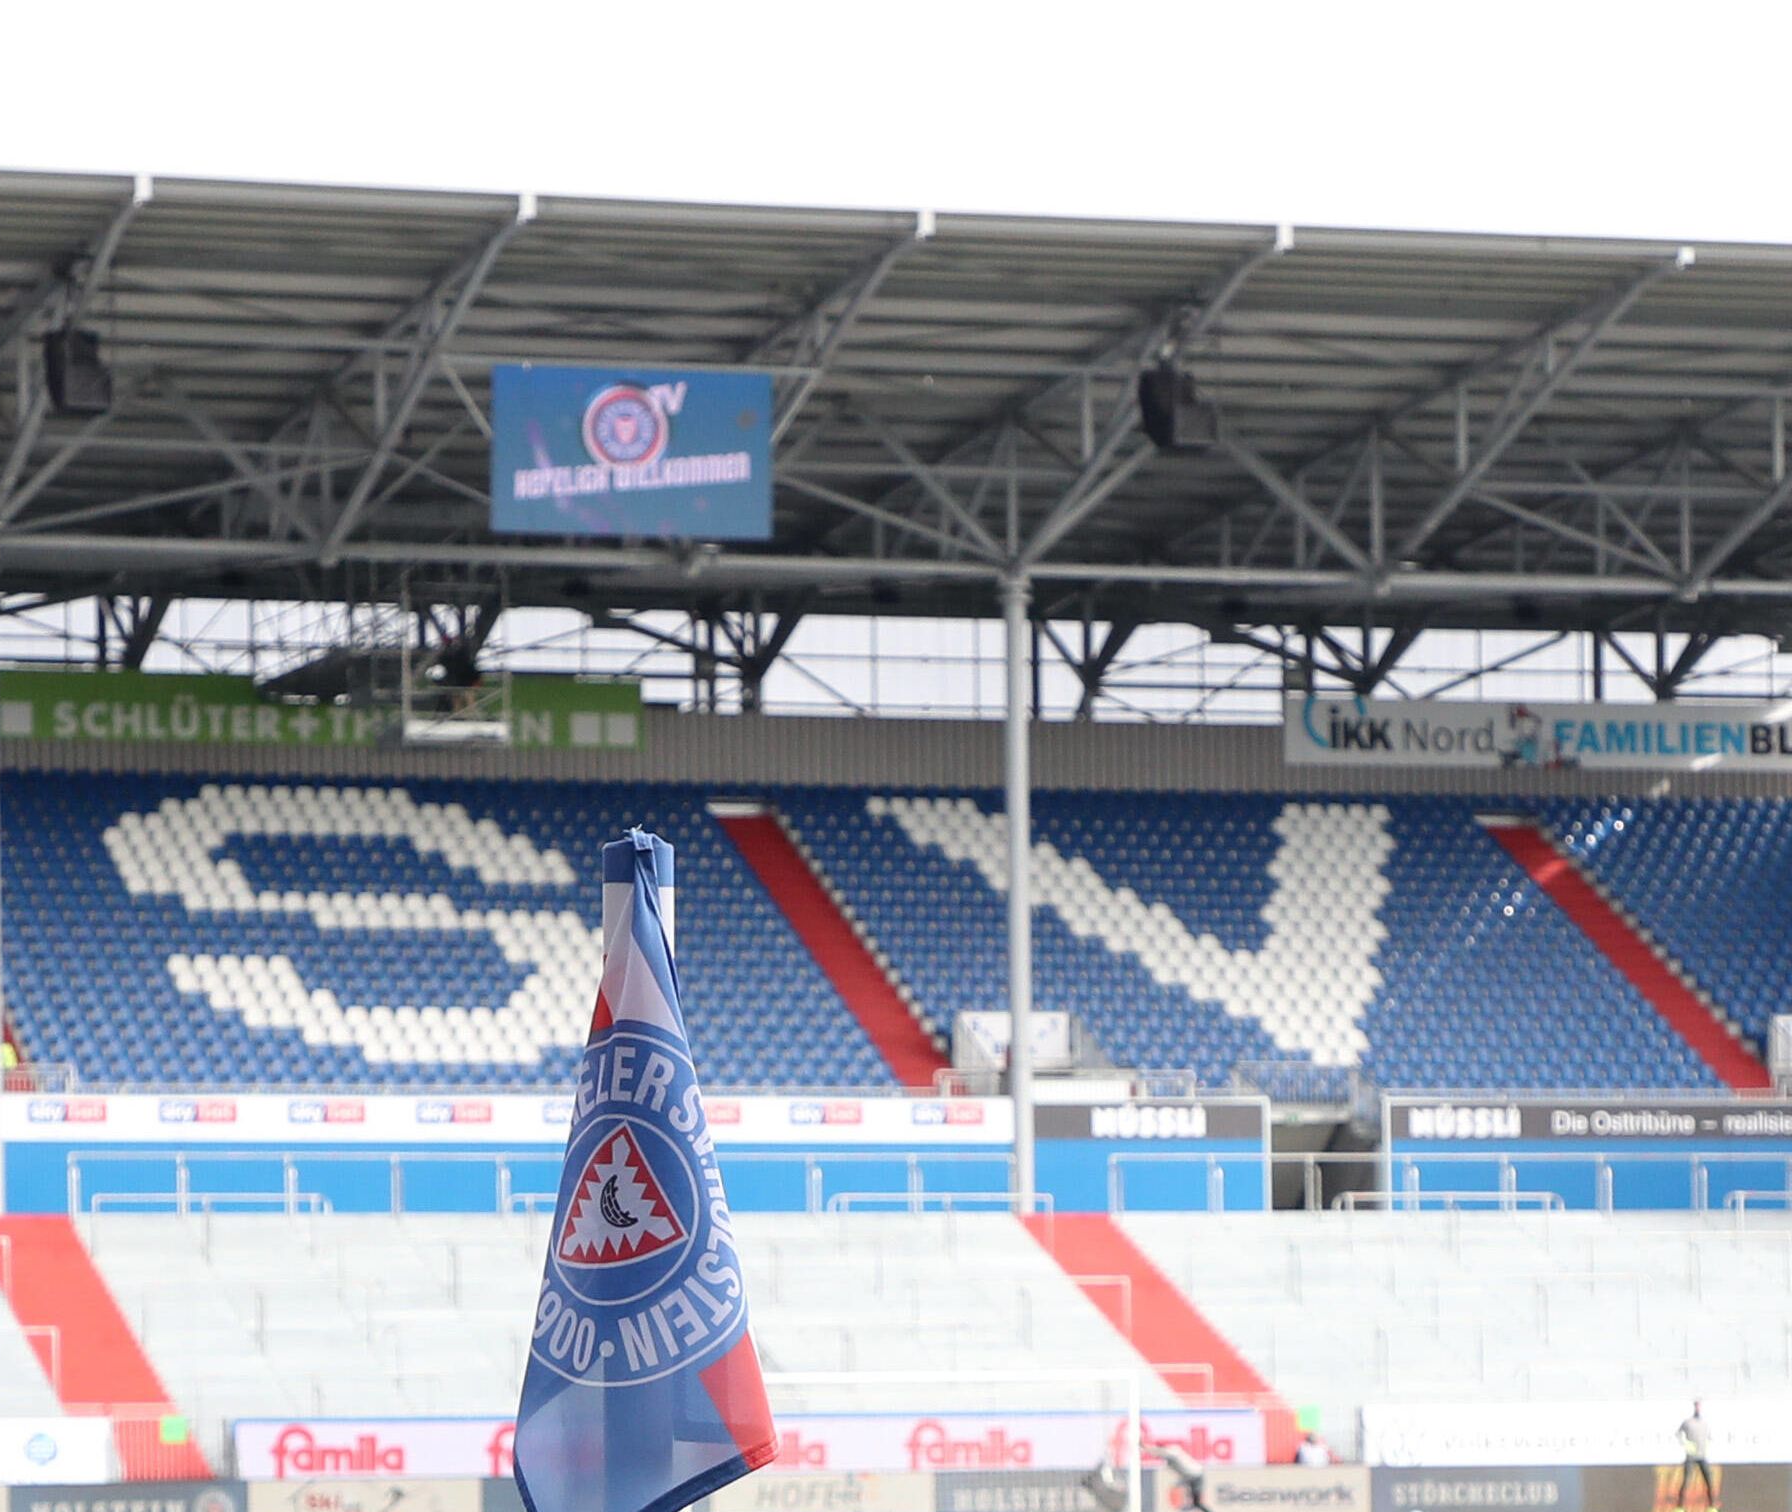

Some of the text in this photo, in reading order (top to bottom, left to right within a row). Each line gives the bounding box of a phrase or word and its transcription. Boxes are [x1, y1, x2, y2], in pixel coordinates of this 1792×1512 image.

[1407, 714, 1497, 754] Nord
[1553, 1111, 1588, 1136] Die
[1595, 1111, 1697, 1136] Osttribüne
[271, 1422, 405, 1478] famila
[907, 1417, 1032, 1470] famila
[1391, 1480, 1559, 1508] STÖRCHECLUB
